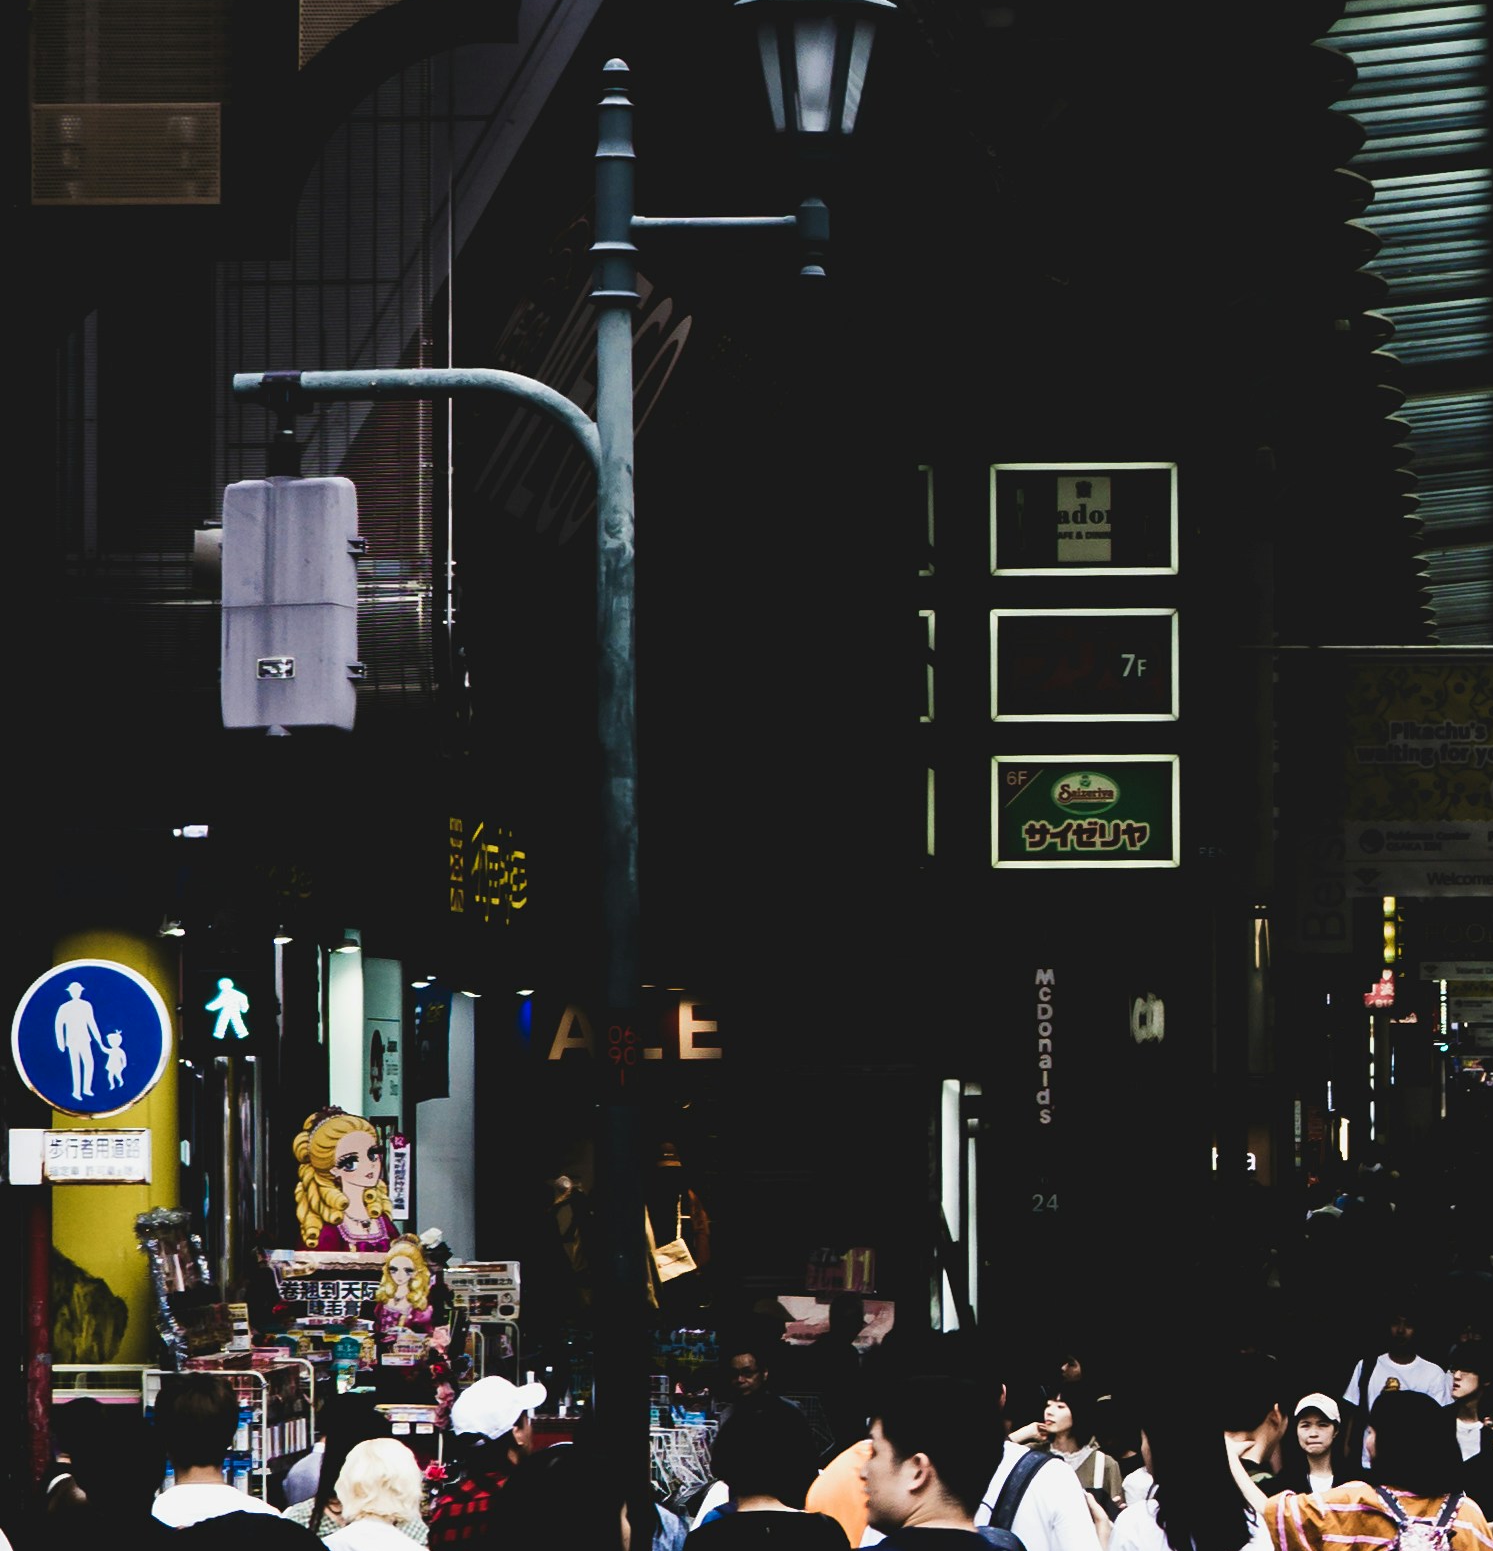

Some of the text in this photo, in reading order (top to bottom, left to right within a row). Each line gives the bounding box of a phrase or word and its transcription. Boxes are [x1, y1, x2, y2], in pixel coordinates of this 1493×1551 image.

[1121, 654, 1147, 678] 7F
[1006, 770, 1028, 786] 6F
[1022, 818, 1150, 851] サイゼリヤ
[1034, 968, 1056, 1124] McDonald's
[50, 1138, 140, 1159] 歩行者用道路
